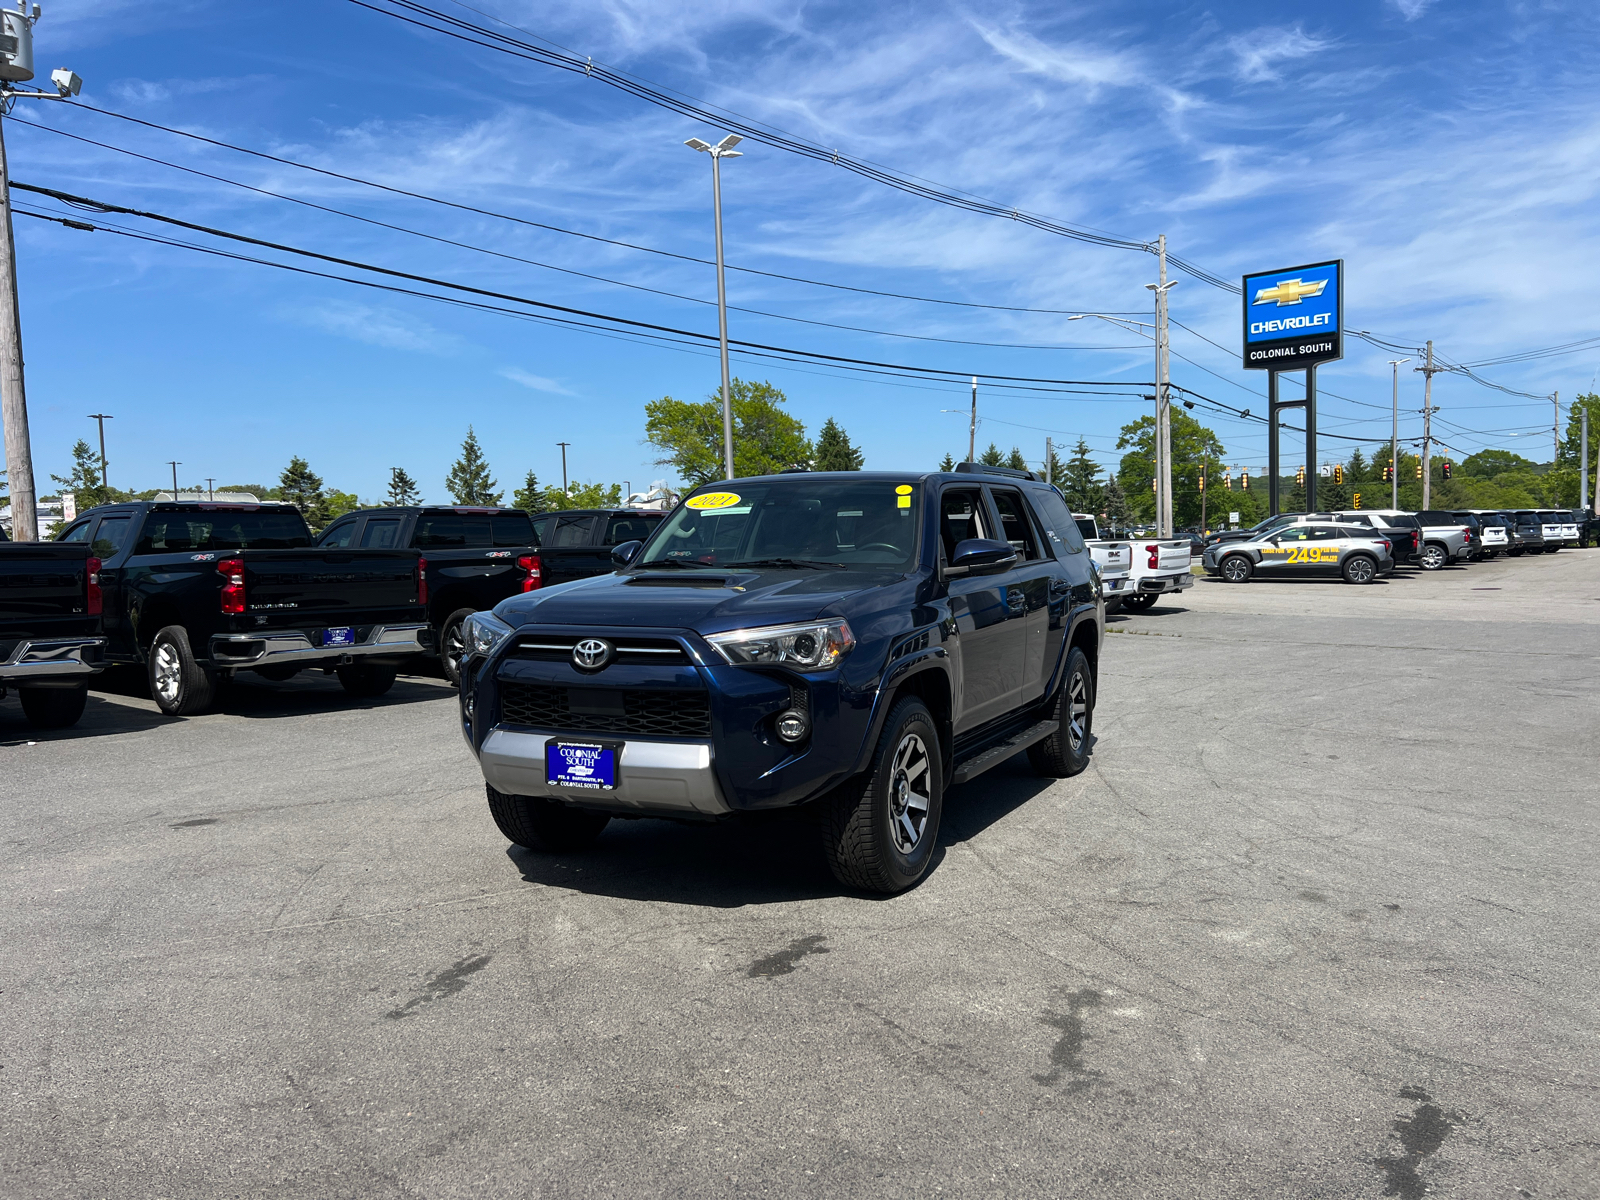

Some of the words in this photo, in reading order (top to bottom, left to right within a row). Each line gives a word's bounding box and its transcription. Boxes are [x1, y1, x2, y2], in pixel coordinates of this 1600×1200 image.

[1251, 313, 1331, 334] CHEVROLET
[1250, 348, 1296, 360] COLONIAL
[1299, 342, 1332, 354] SOUTH
[692, 496, 733, 506] 2021
[560, 748, 601, 759] COLONIAL
[566, 757, 594, 766] SOUTH
